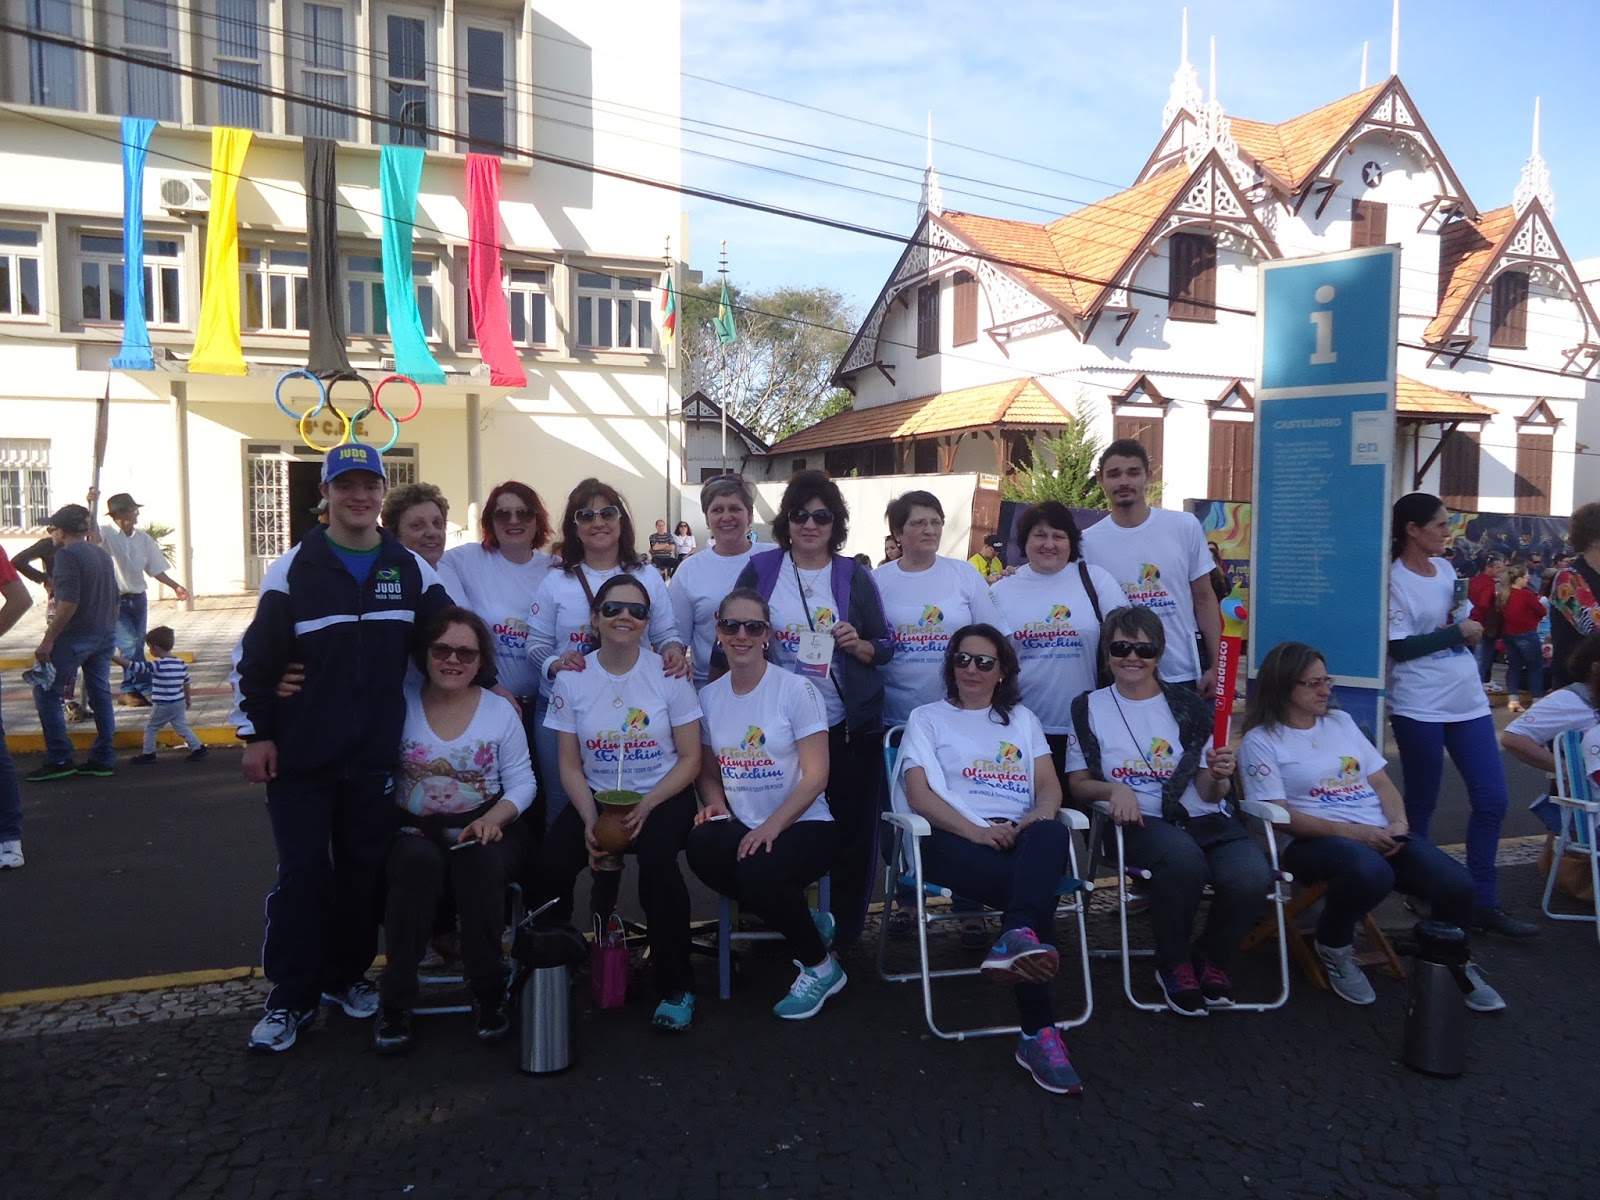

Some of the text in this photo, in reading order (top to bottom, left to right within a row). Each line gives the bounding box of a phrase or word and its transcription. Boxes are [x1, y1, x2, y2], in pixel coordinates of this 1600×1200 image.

[1274, 418, 1342, 429] CASTELINHO
[1357, 442, 1378, 453] en
[375, 580, 402, 593] JUDÔ
[1125, 590, 1168, 602] mpica
[895, 632, 950, 645] límpica
[1022, 637, 1083, 649] Erechim
[895, 641, 947, 653] Erechi
[1216, 641, 1228, 695] Bradesco
[720, 747, 767, 758] Tocha
[718, 755, 775, 771] límpica
[973, 759, 1023, 772] Tocha
[722, 767, 783, 779] Erechim
